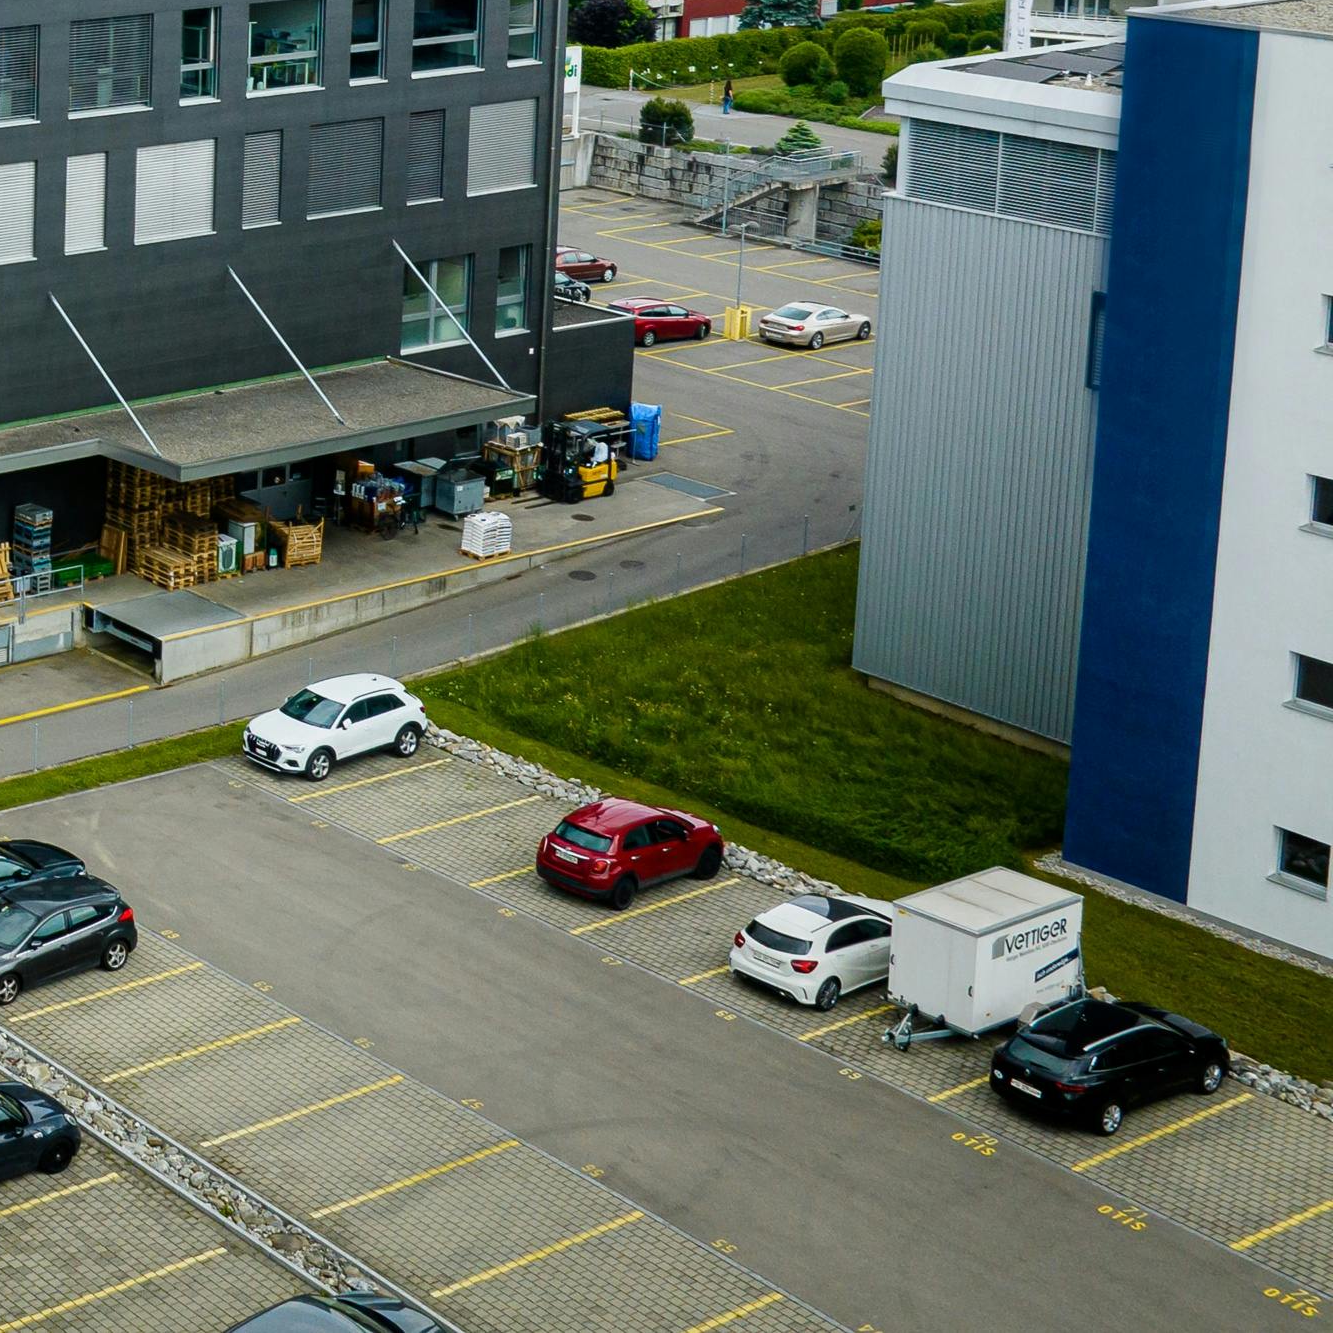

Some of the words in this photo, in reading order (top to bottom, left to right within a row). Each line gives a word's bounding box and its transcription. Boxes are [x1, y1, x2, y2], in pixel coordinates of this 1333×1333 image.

[838, 1067, 863, 1081] 69
[950, 1132, 997, 1158] OTIS
[974, 1132, 1000, 1146] 70
[1097, 1203, 1149, 1232] OTIS
[1261, 1286, 1322, 1318] OTIS
[1290, 1289, 1323, 1307] 72
